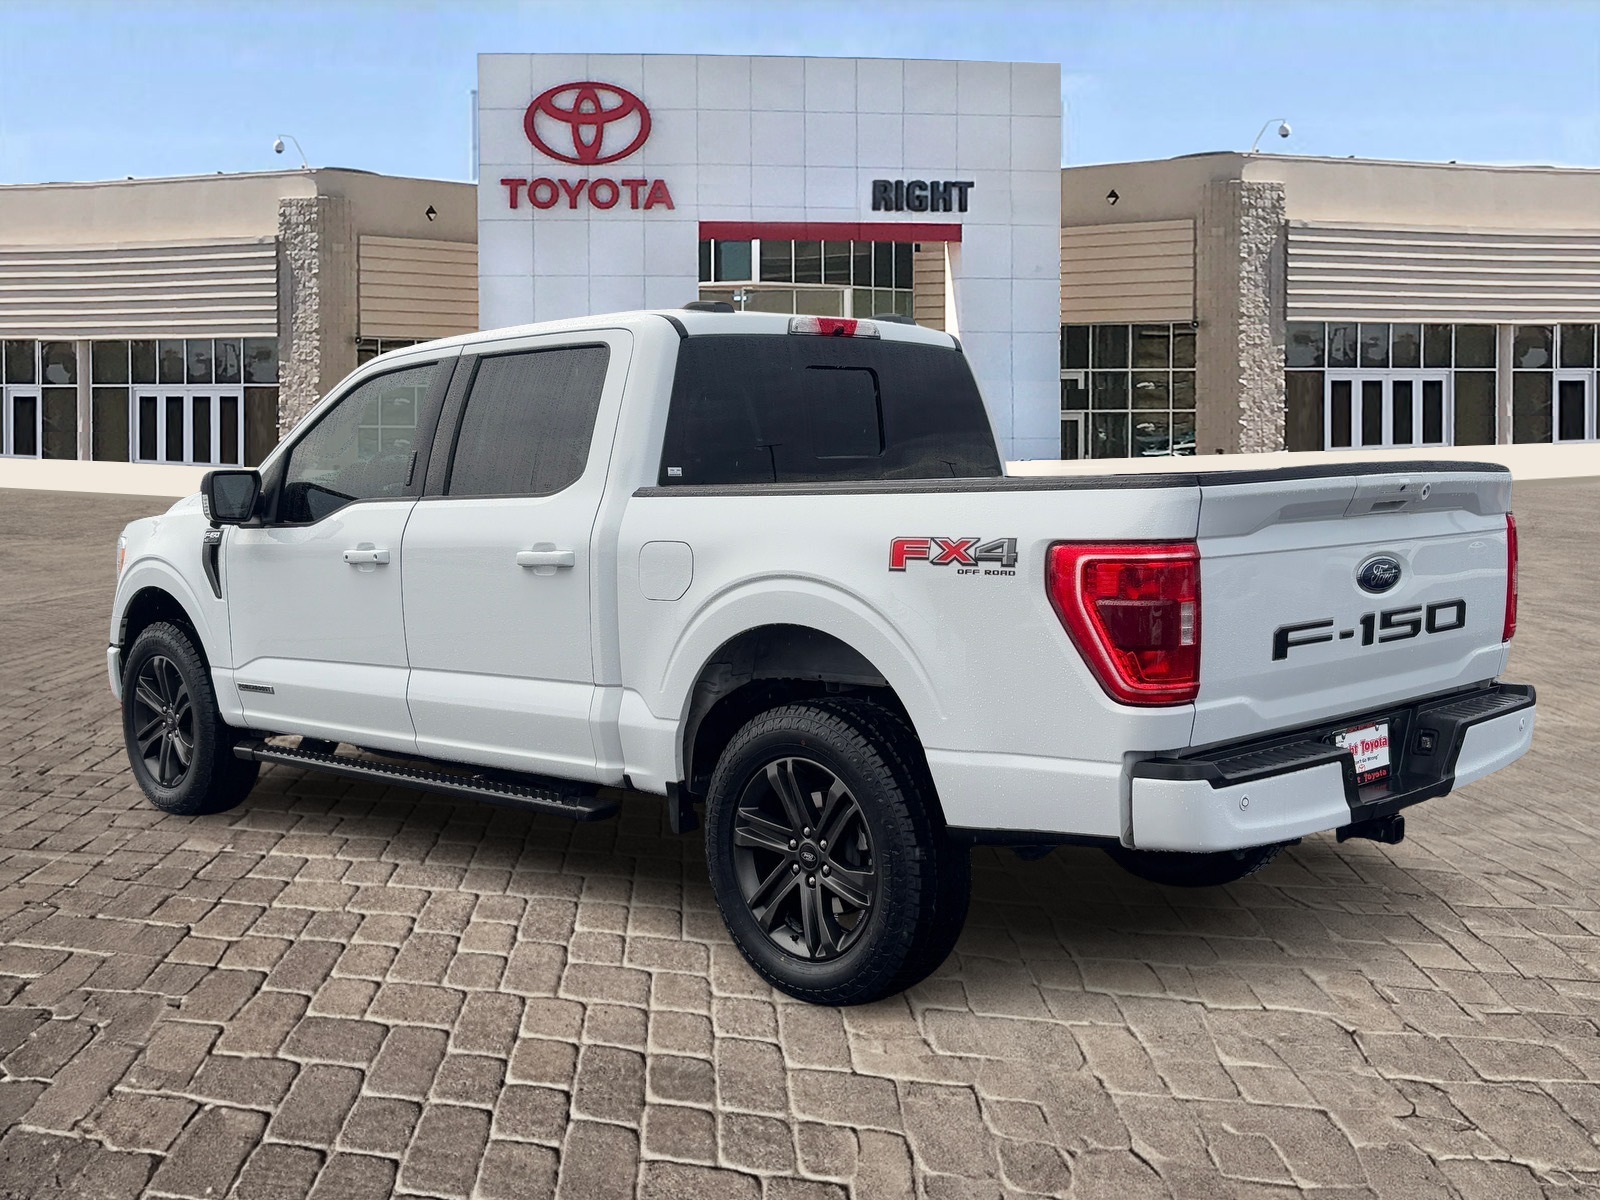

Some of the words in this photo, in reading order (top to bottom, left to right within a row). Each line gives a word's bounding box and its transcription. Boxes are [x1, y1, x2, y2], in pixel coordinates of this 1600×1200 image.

[500, 177, 675, 210] TOYOTA
[871, 178, 974, 213] RIGHT
[888, 536, 1018, 572] FX4
[1371, 564, 1398, 586] Ford
[1271, 598, 1467, 661] F-150
[1360, 735, 1388, 756] Toyota
